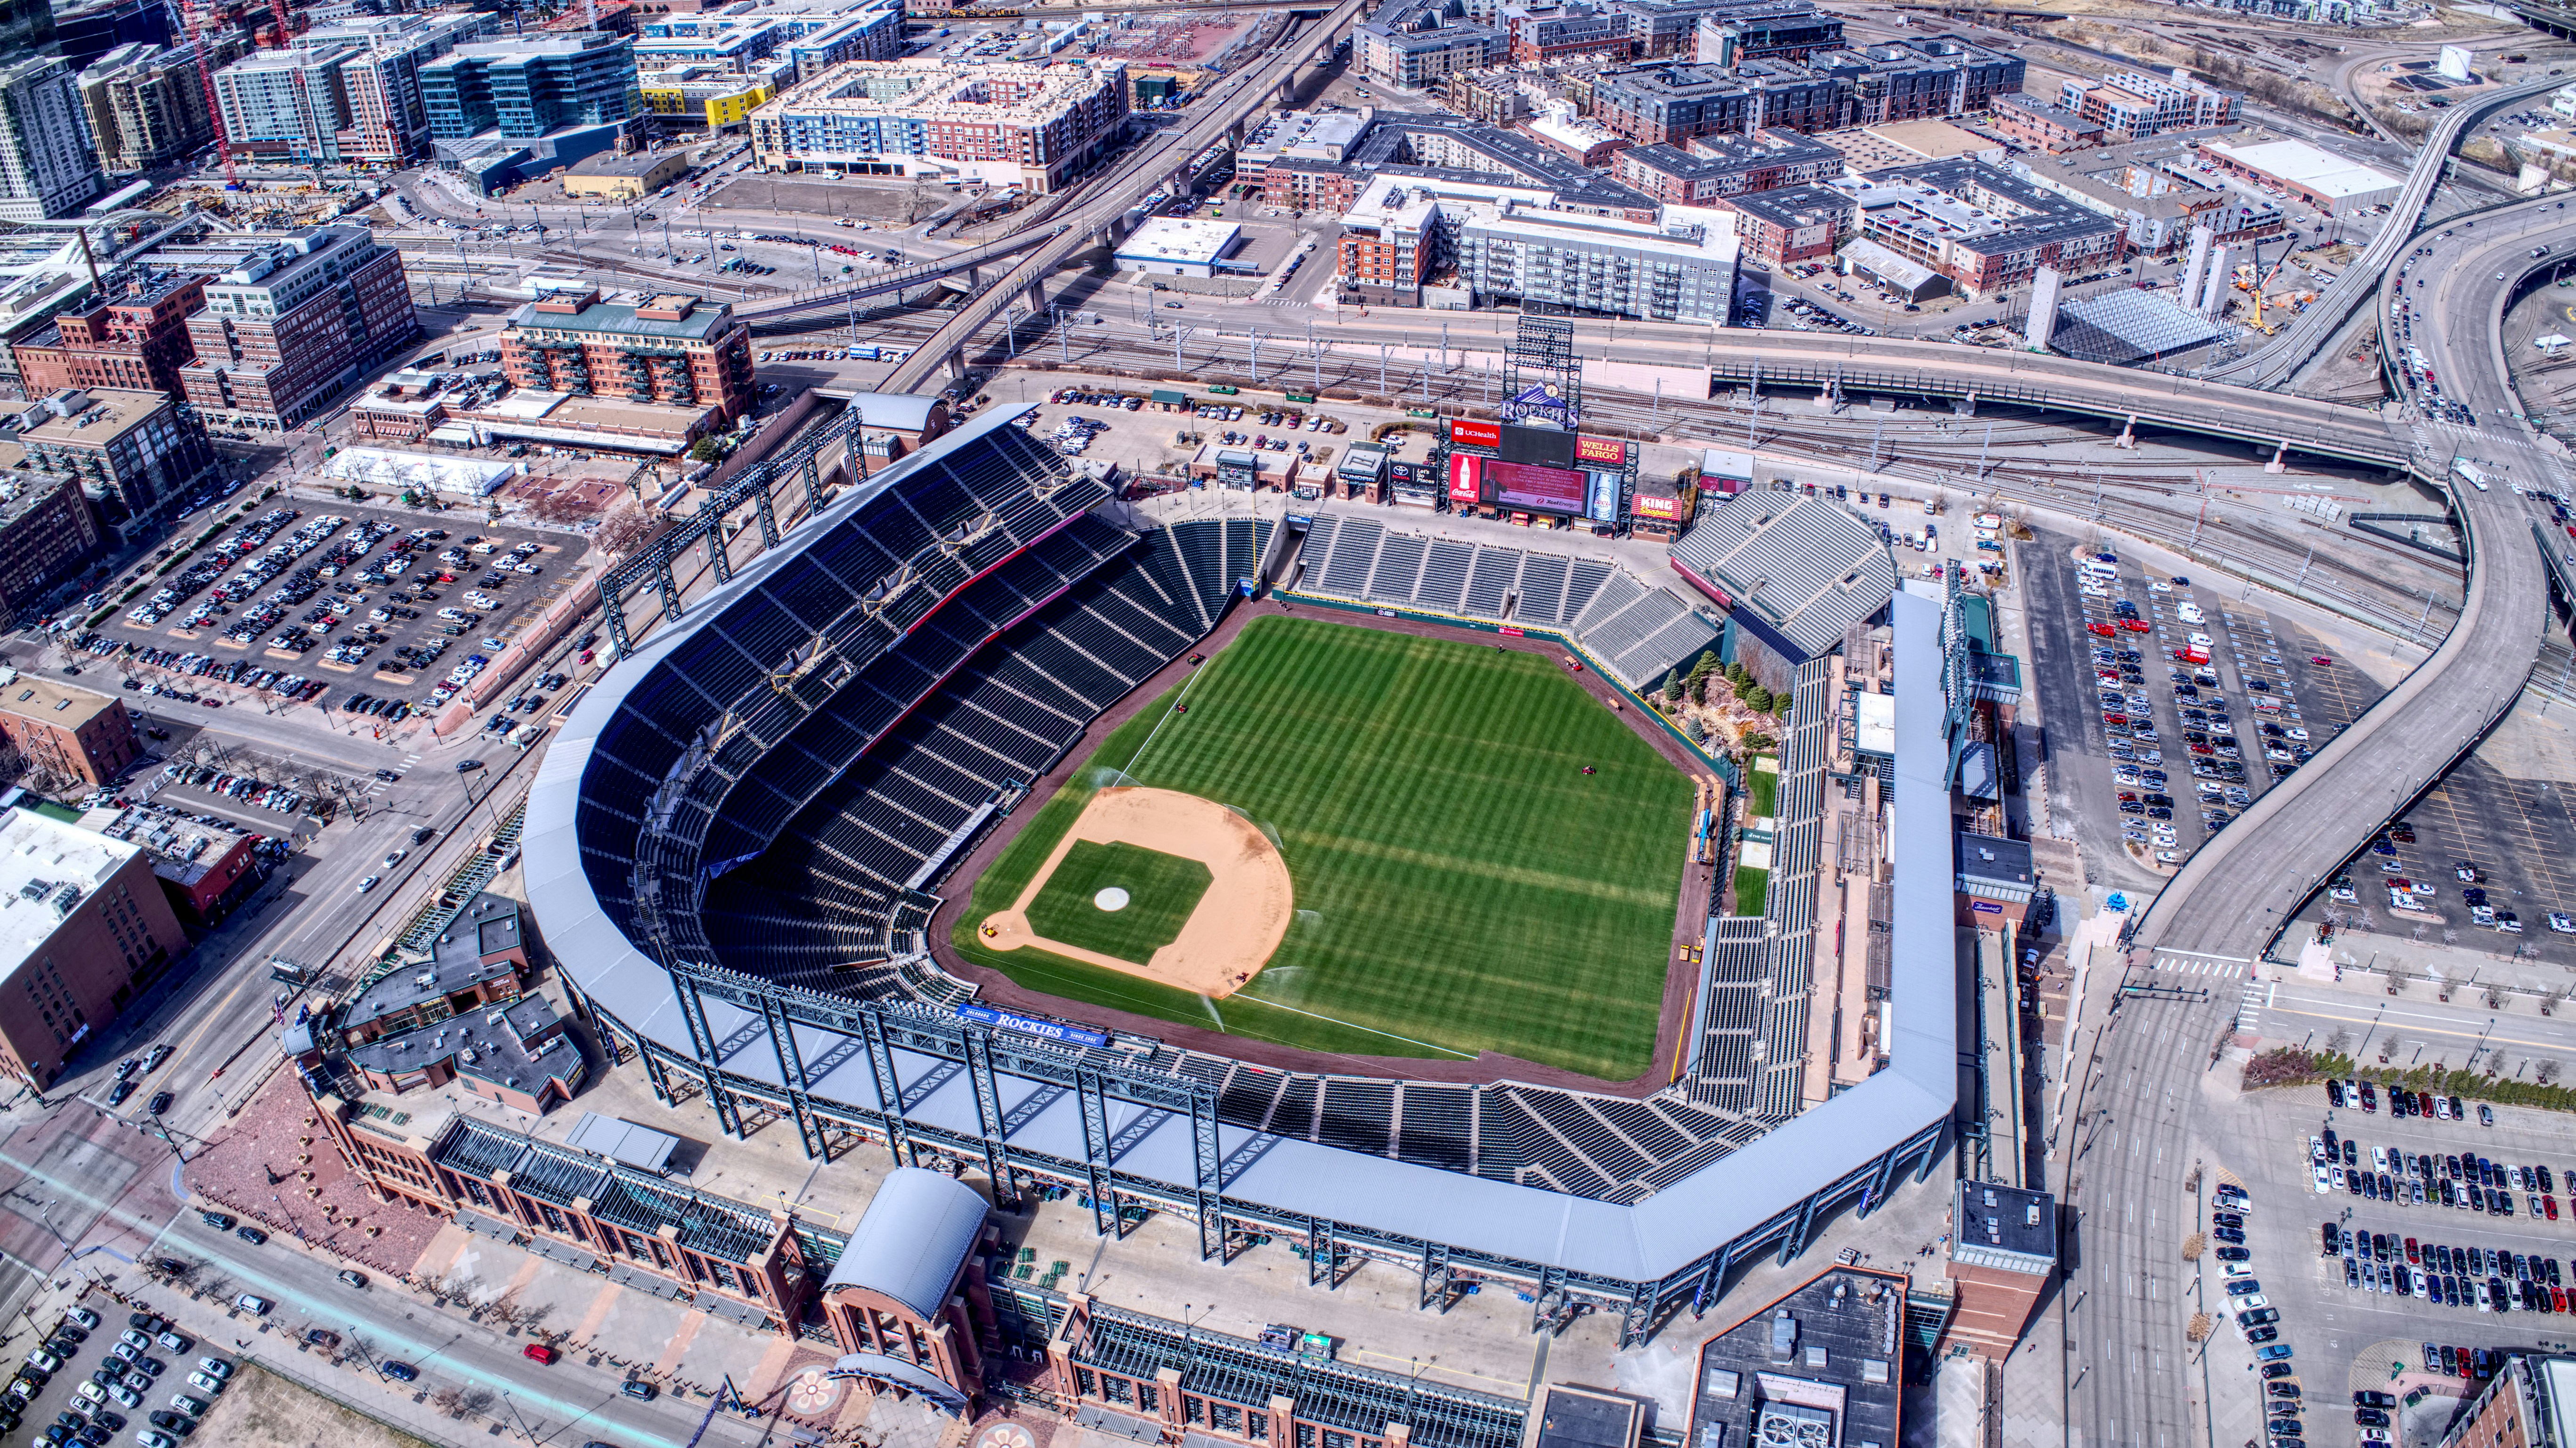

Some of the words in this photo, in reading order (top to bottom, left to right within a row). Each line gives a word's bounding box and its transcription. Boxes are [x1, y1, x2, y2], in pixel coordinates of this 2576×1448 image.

[2049, 125, 2066, 138] SUPPLY
[1499, 400, 1579, 428] ROCKIES
[1465, 430, 1497, 439] UCHealth
[1580, 440, 1619, 453] WELLS
[1580, 448, 1618, 461] FARGO
[1340, 473, 1375, 482] TUNDRA
[1559, 500, 1577, 508] Energy
[1594, 496, 1611, 506] Coors
[1641, 497, 1673, 510] KING
[1639, 506, 1673, 517] Soopers
[948, 825, 973, 845] COORS
[930, 846, 952, 865] FIELD
[966, 1009, 989, 1019] COLORADO
[996, 1013, 1064, 1038] ROCKIES
[2330, 1340, 2338, 1348] 12
